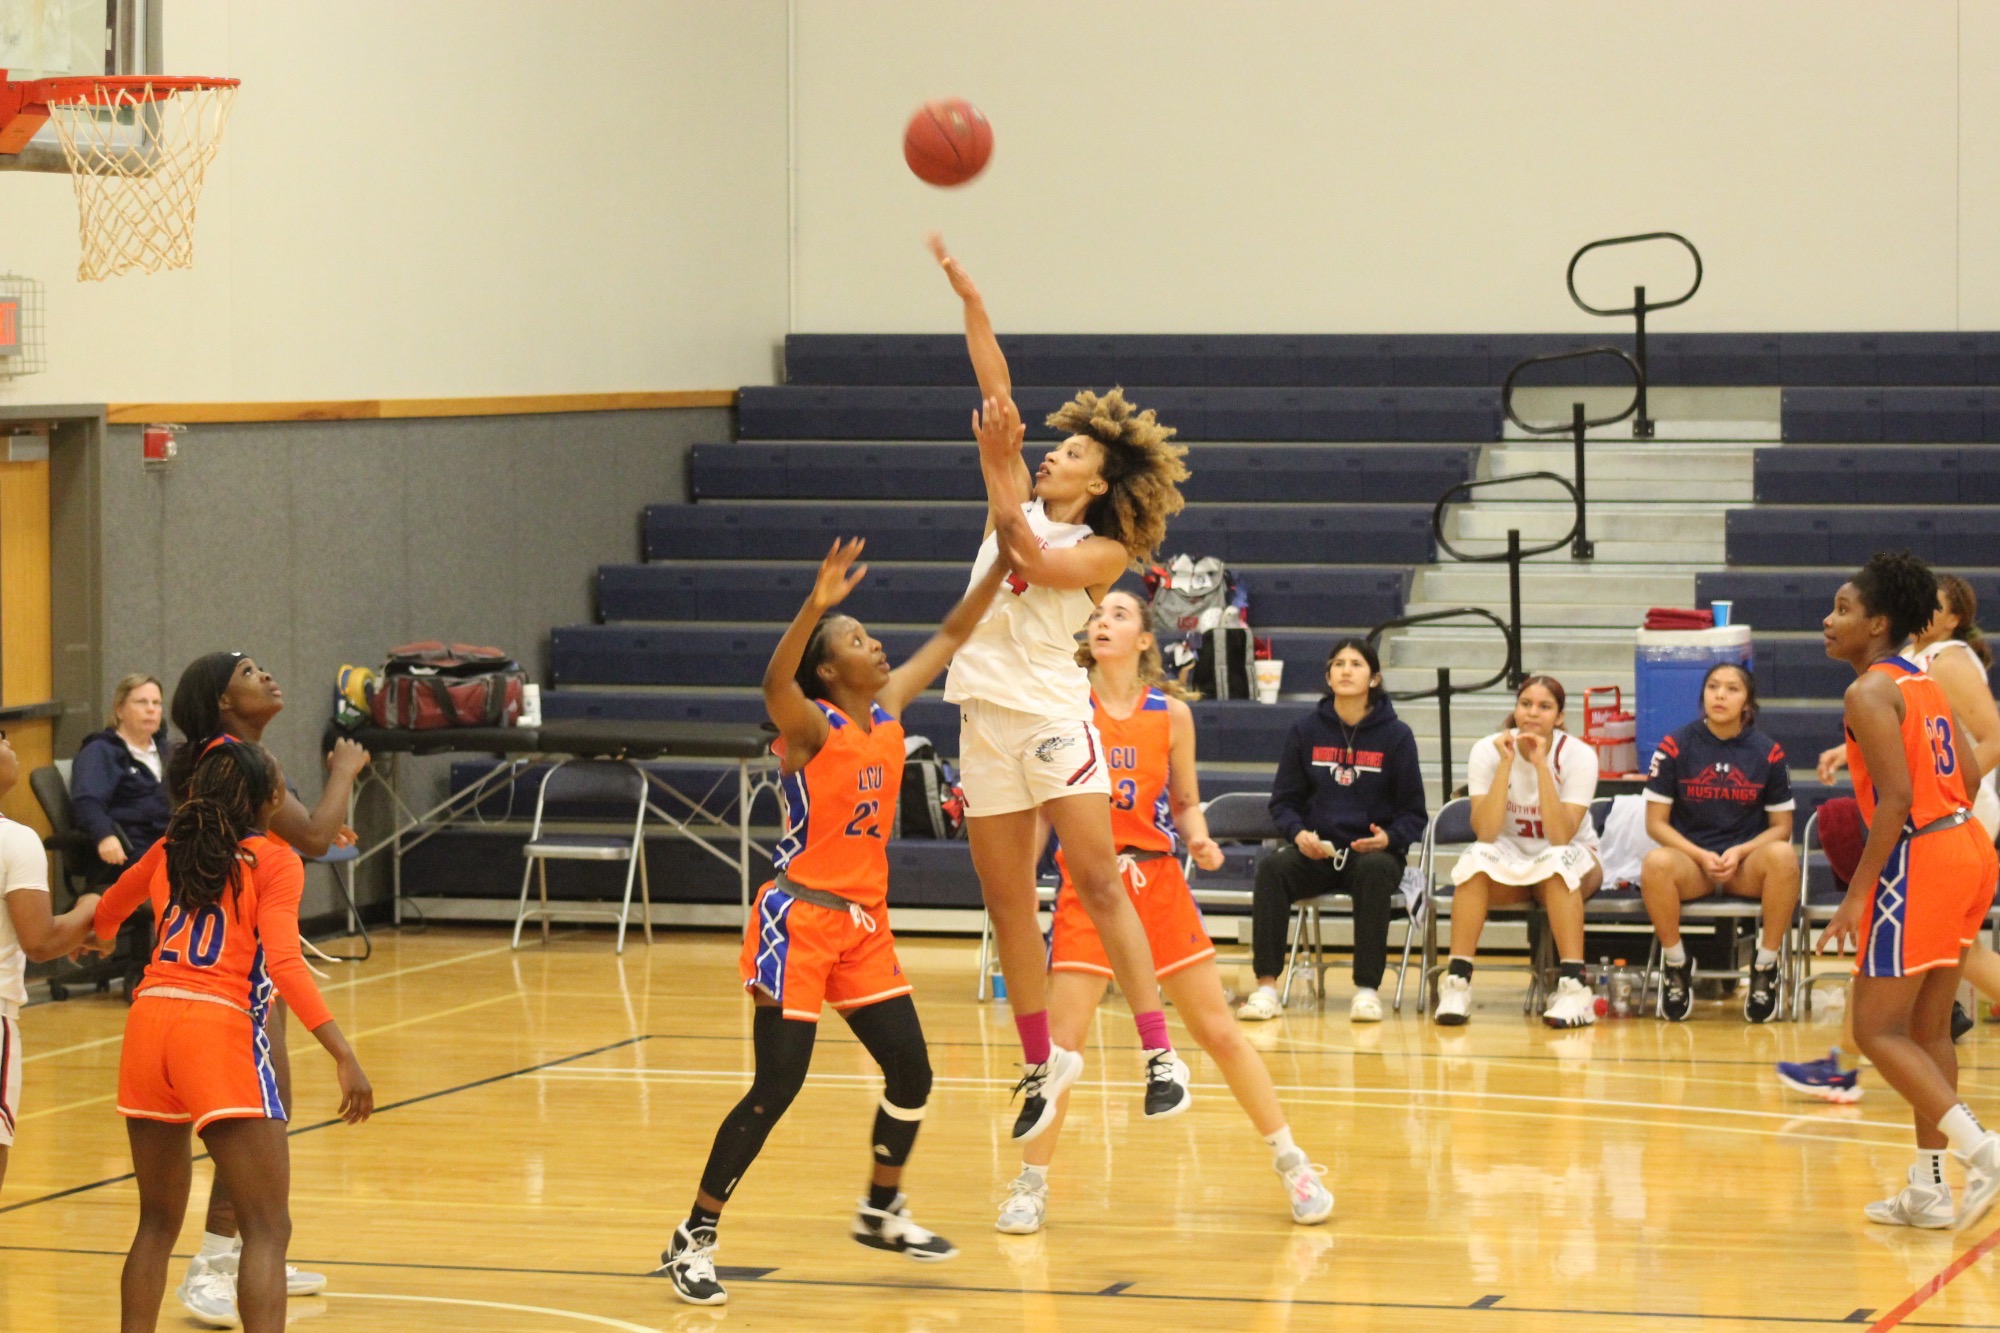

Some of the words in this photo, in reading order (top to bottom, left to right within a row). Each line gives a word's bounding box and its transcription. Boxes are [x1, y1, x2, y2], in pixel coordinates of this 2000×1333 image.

[1104, 746, 1136, 770] CU
[1686, 785, 1757, 801] MUSTANGS
[844, 800, 882, 839] 22
[1506, 802, 1541, 815] OUTHW
[159, 899, 227, 968] 20
